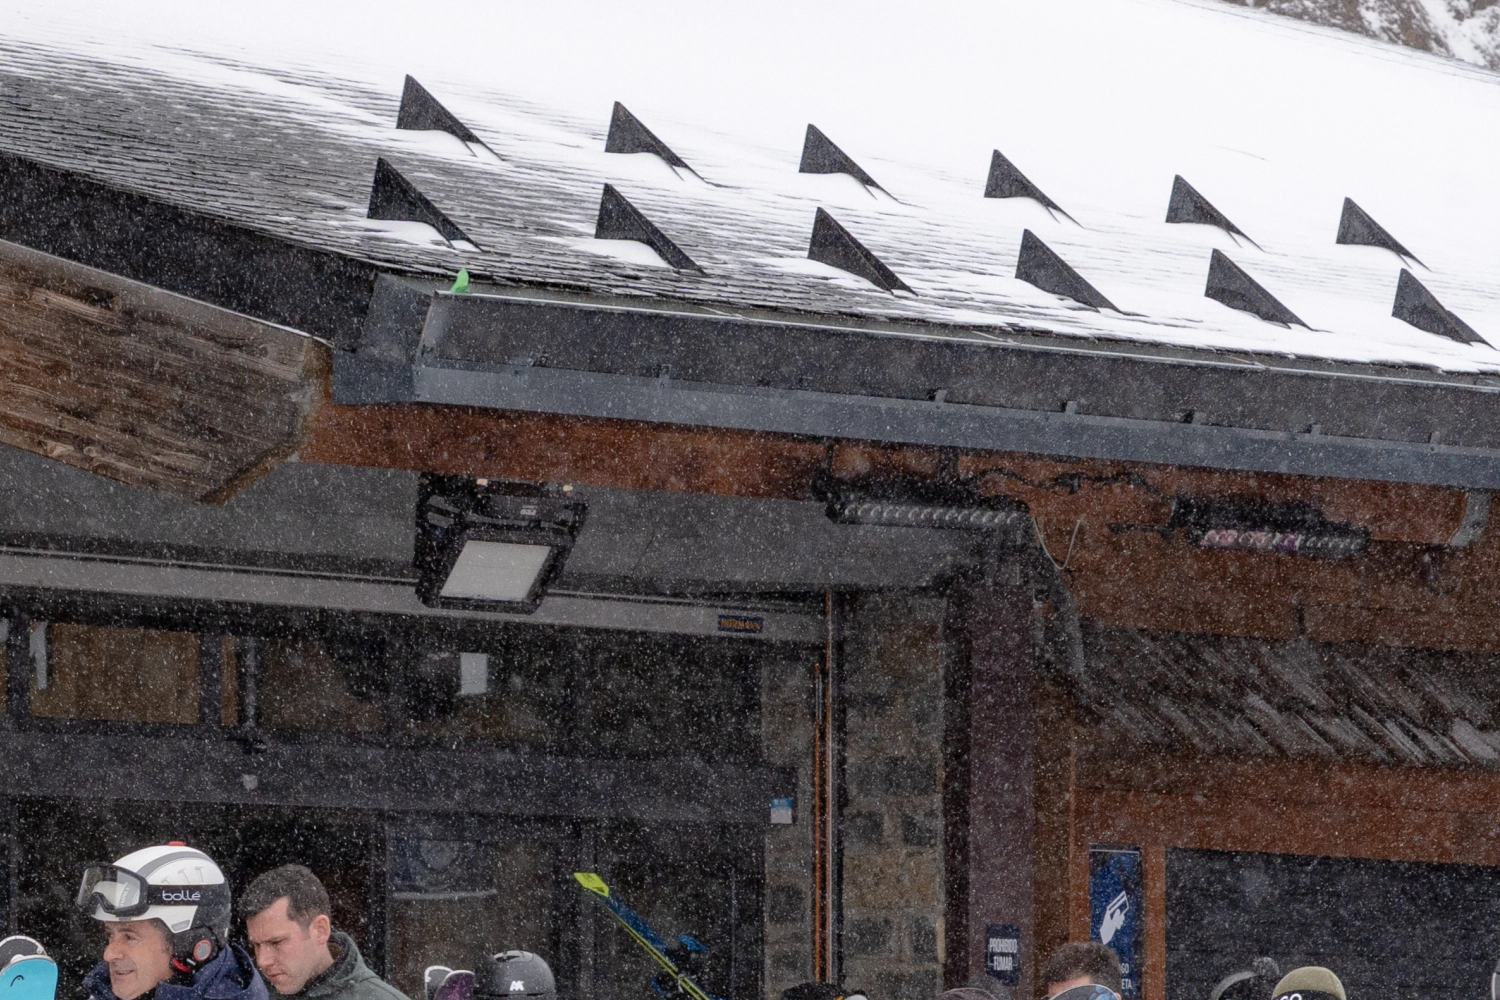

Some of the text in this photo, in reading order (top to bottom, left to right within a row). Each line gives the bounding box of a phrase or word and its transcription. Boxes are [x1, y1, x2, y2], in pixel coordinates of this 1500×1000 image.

[162, 889, 201, 901] bollé
[989, 938, 1018, 953] PROHIBIDO
[993, 956, 1013, 970] FUMAR
